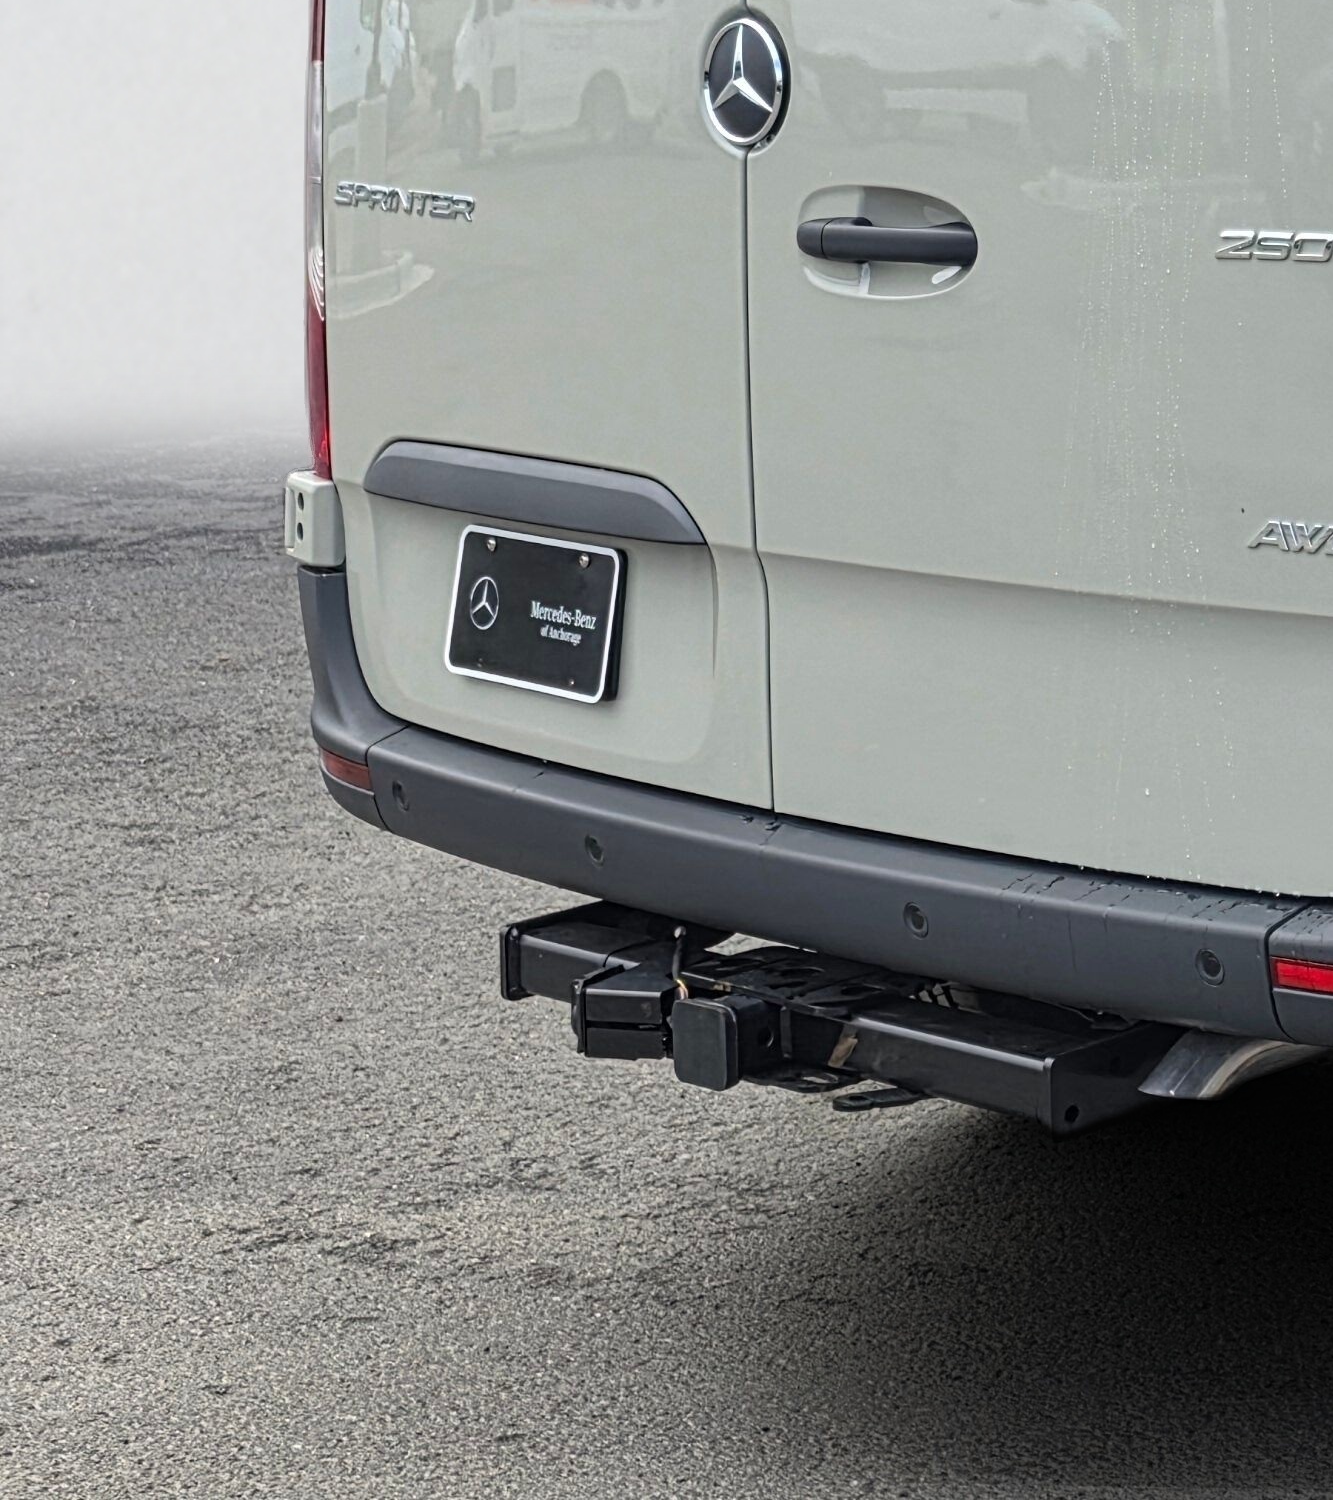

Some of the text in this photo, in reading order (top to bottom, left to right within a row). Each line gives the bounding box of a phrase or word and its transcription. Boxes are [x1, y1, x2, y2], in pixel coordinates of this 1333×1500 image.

[334, 181, 476, 222] SPRINTER
[530, 600, 597, 629] Mercedes-Benz
[540, 624, 581, 646] of Anchorage
